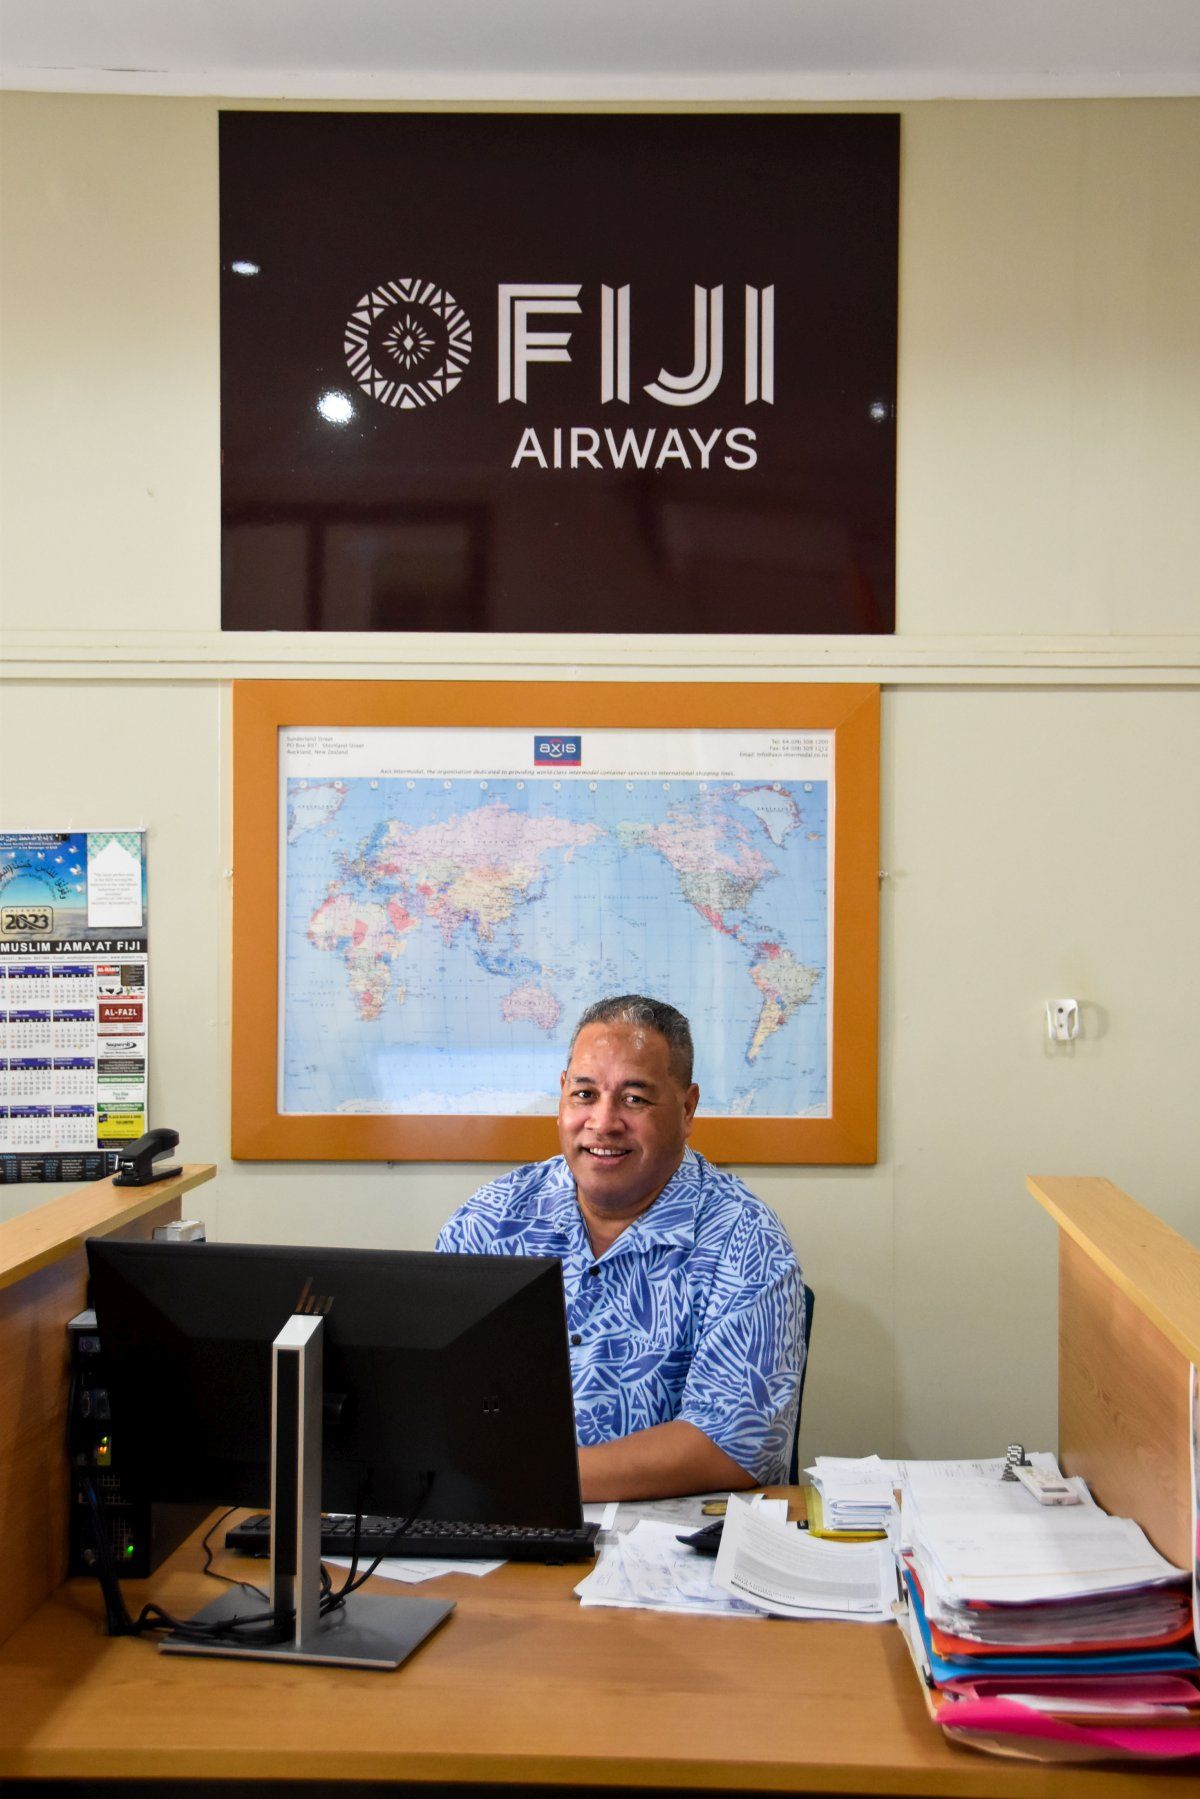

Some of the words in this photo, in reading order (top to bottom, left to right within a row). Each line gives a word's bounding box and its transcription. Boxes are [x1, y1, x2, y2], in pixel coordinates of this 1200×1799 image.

[498, 283, 774, 406] FIJI
[510, 427, 758, 470] AIRWAYS
[508, 769, 535, 777] providing
[5, 914, 49, 930] 2023
[0, 941, 51, 952] MUSLIM
[56, 941, 112, 952] JAMA'AT
[117, 940, 140, 951] FIJI
[105, 1008, 138, 1016] AL-FAZL
